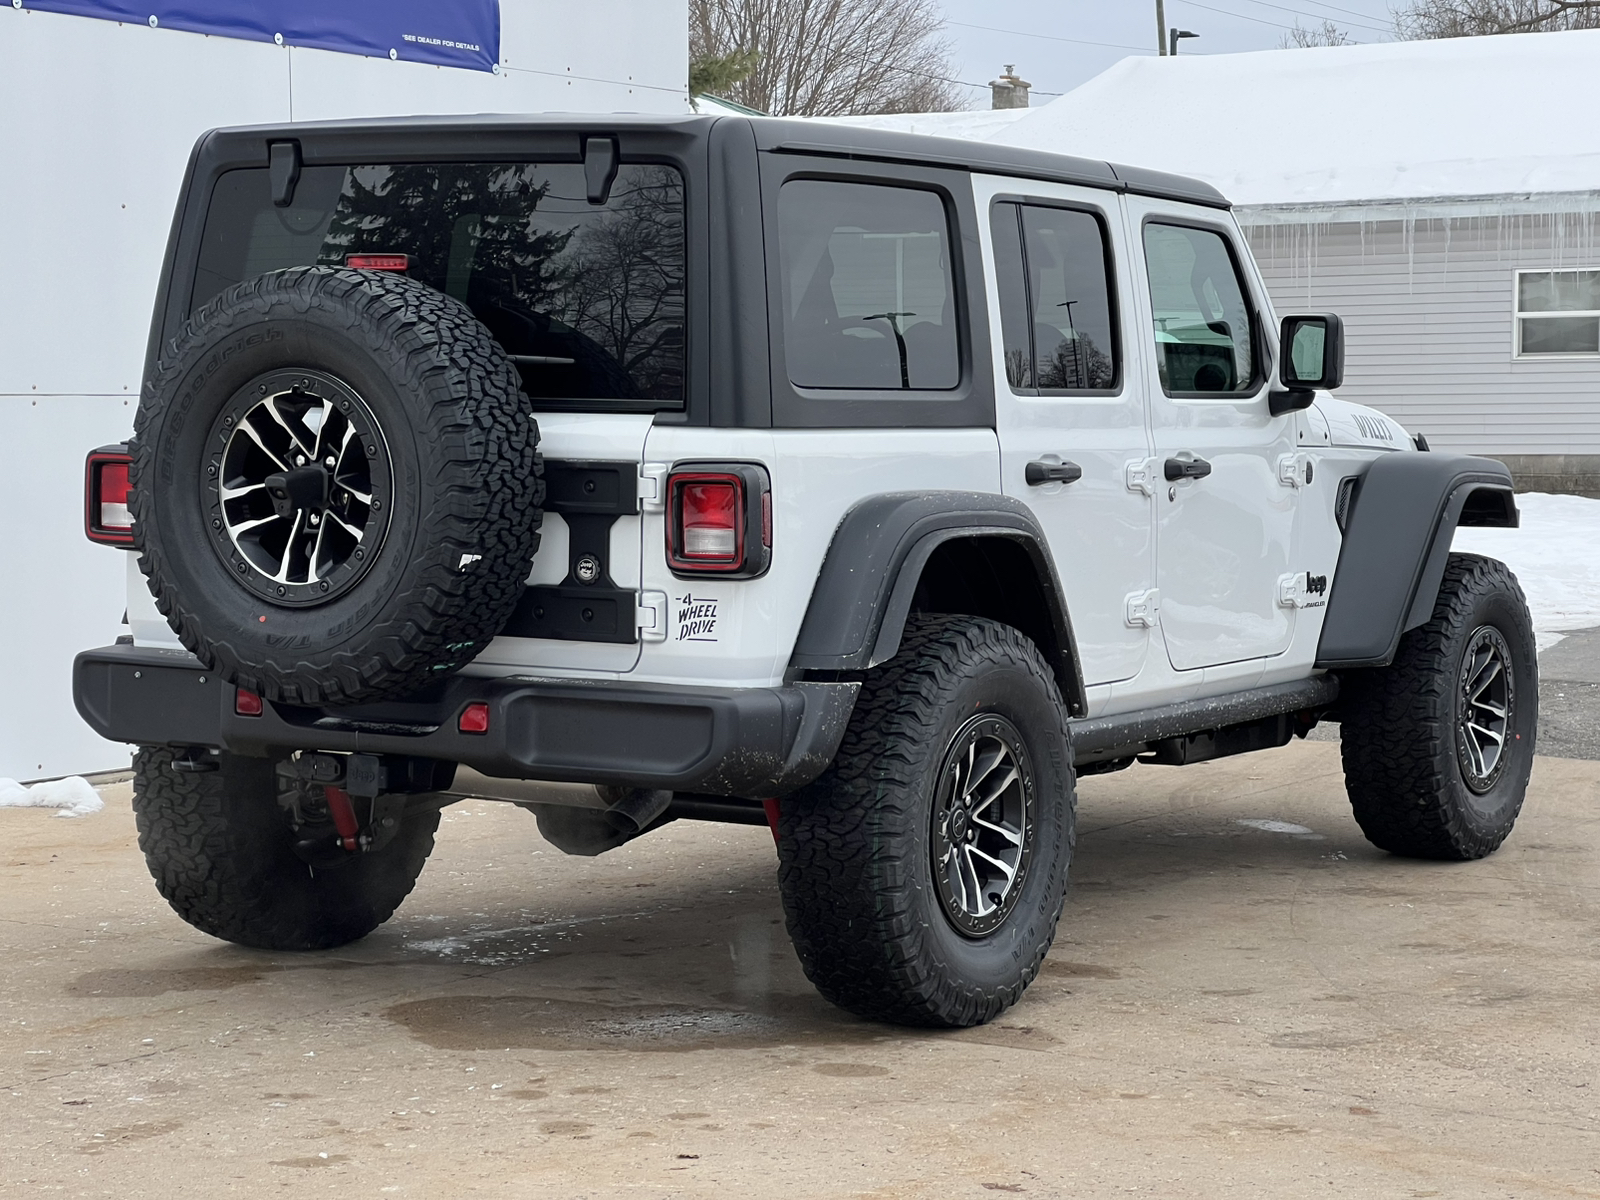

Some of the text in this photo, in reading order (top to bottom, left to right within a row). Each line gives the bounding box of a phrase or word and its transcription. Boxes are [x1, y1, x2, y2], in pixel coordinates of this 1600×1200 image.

[417, 36, 441, 45] DEALER
[455, 42, 480, 51] DETAILS
[160, 327, 284, 486] BFGoodrich
[1349, 413, 1394, 441] WILLYS
[1304, 571, 1327, 597] Jeep
[682, 593, 693, 606] 4
[678, 604, 717, 623] WHEEL
[679, 620, 717, 641] DRIVE
